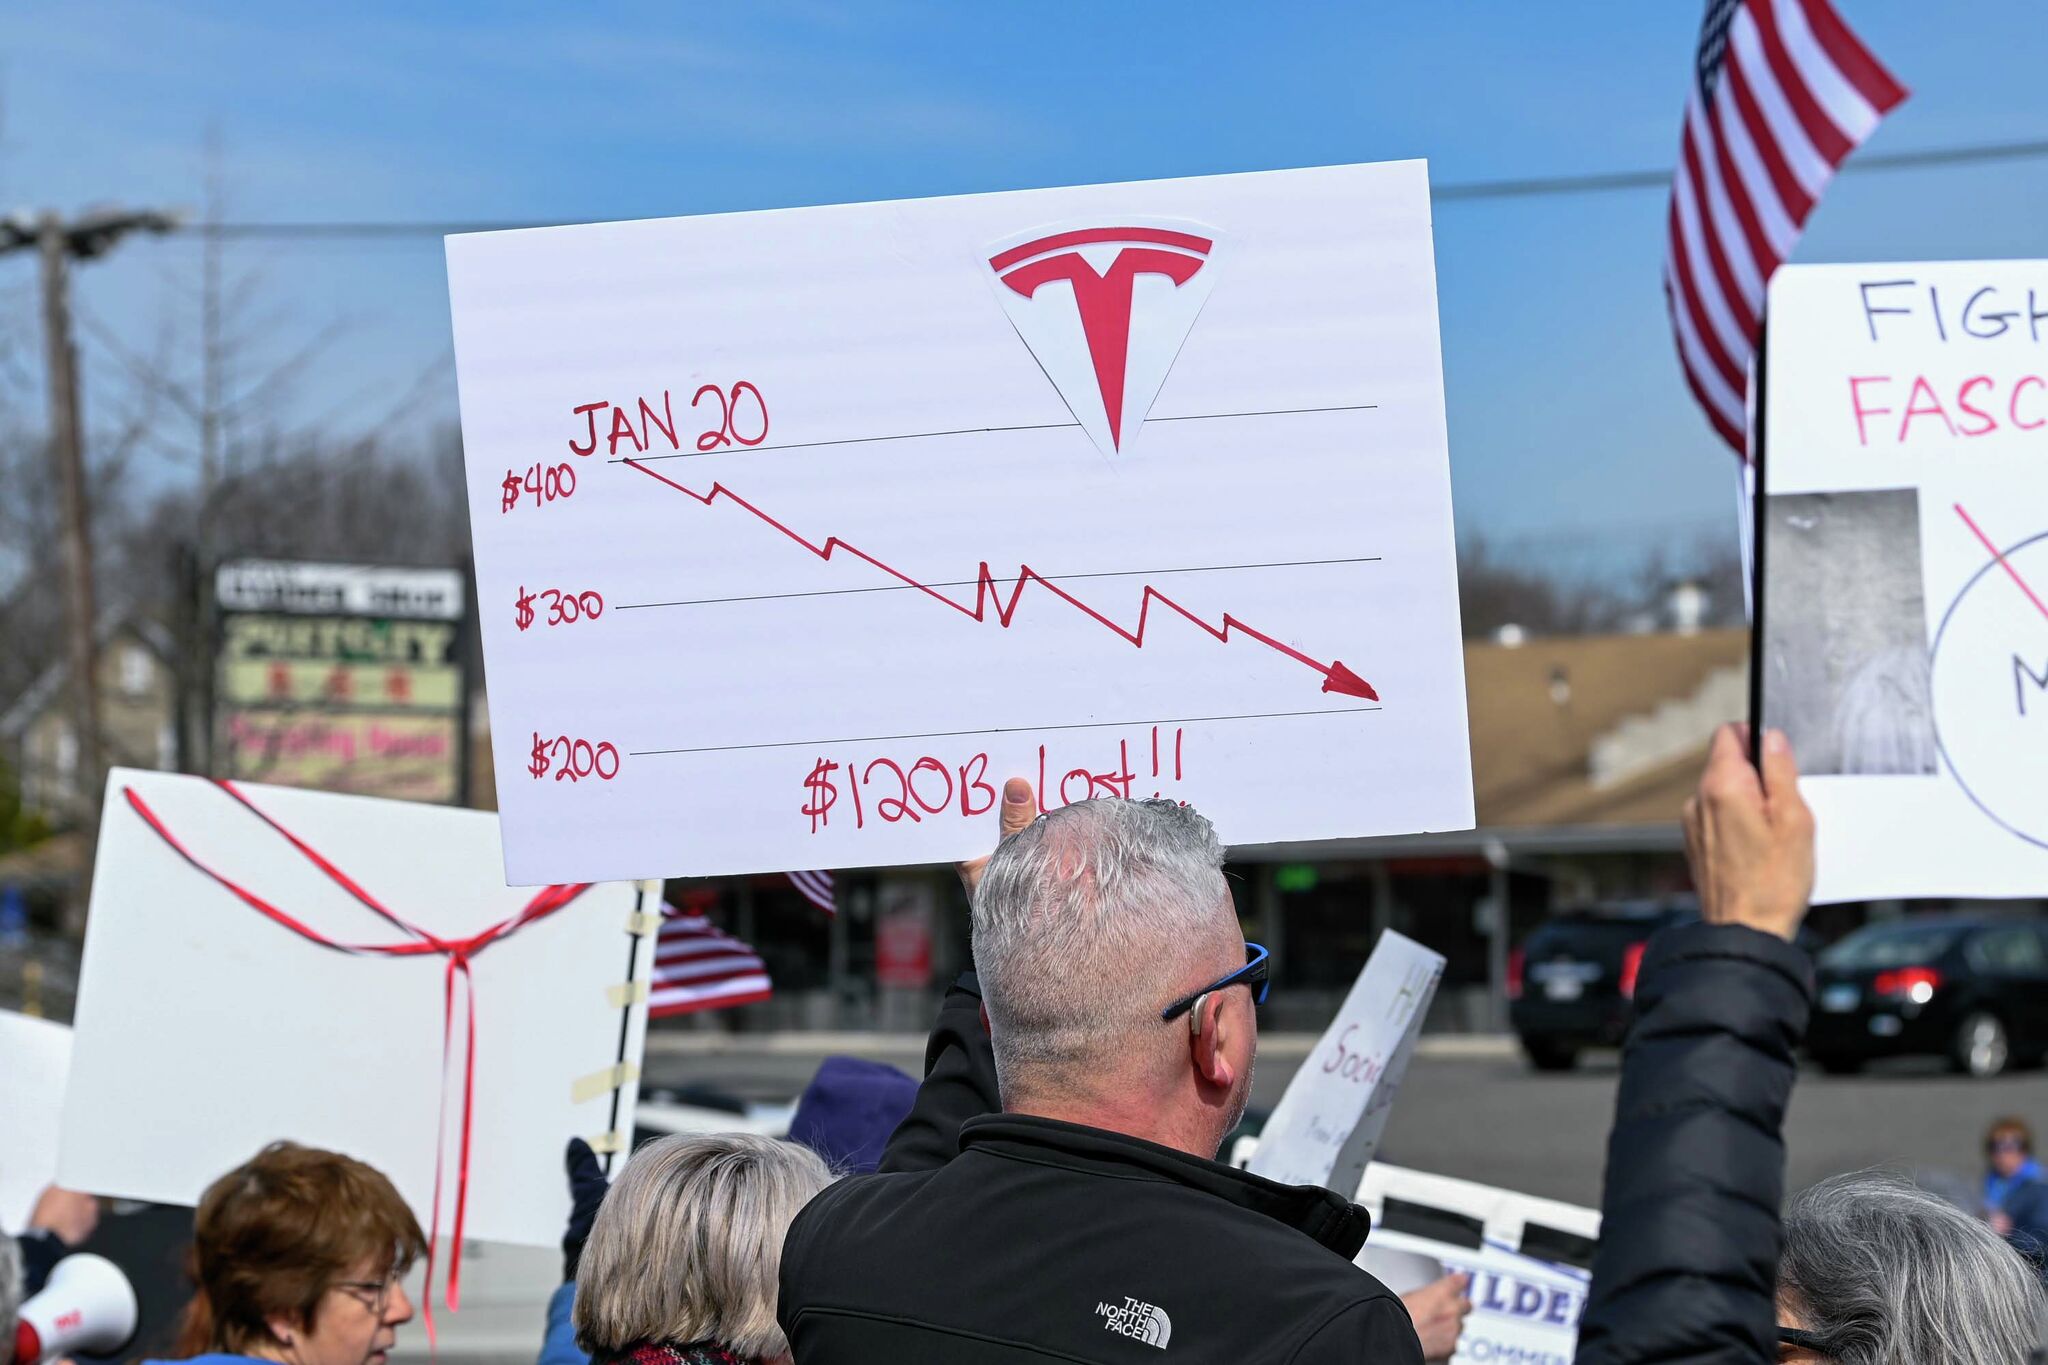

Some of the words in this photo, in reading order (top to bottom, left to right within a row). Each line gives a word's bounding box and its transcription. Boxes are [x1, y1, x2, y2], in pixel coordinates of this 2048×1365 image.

[569, 390, 679, 457] JAN
[691, 380, 769, 452] 20
[1848, 374, 2048, 446] FASC
[501, 462, 577, 514] $400
[515, 585, 605, 632] $300
[527, 731, 620, 783] $200
[801, 752, 997, 834] $120B
[1094, 1301, 1150, 1330] NORTH
[1104, 1318, 1144, 1341] FACE
[1124, 1295, 1154, 1317] THE
